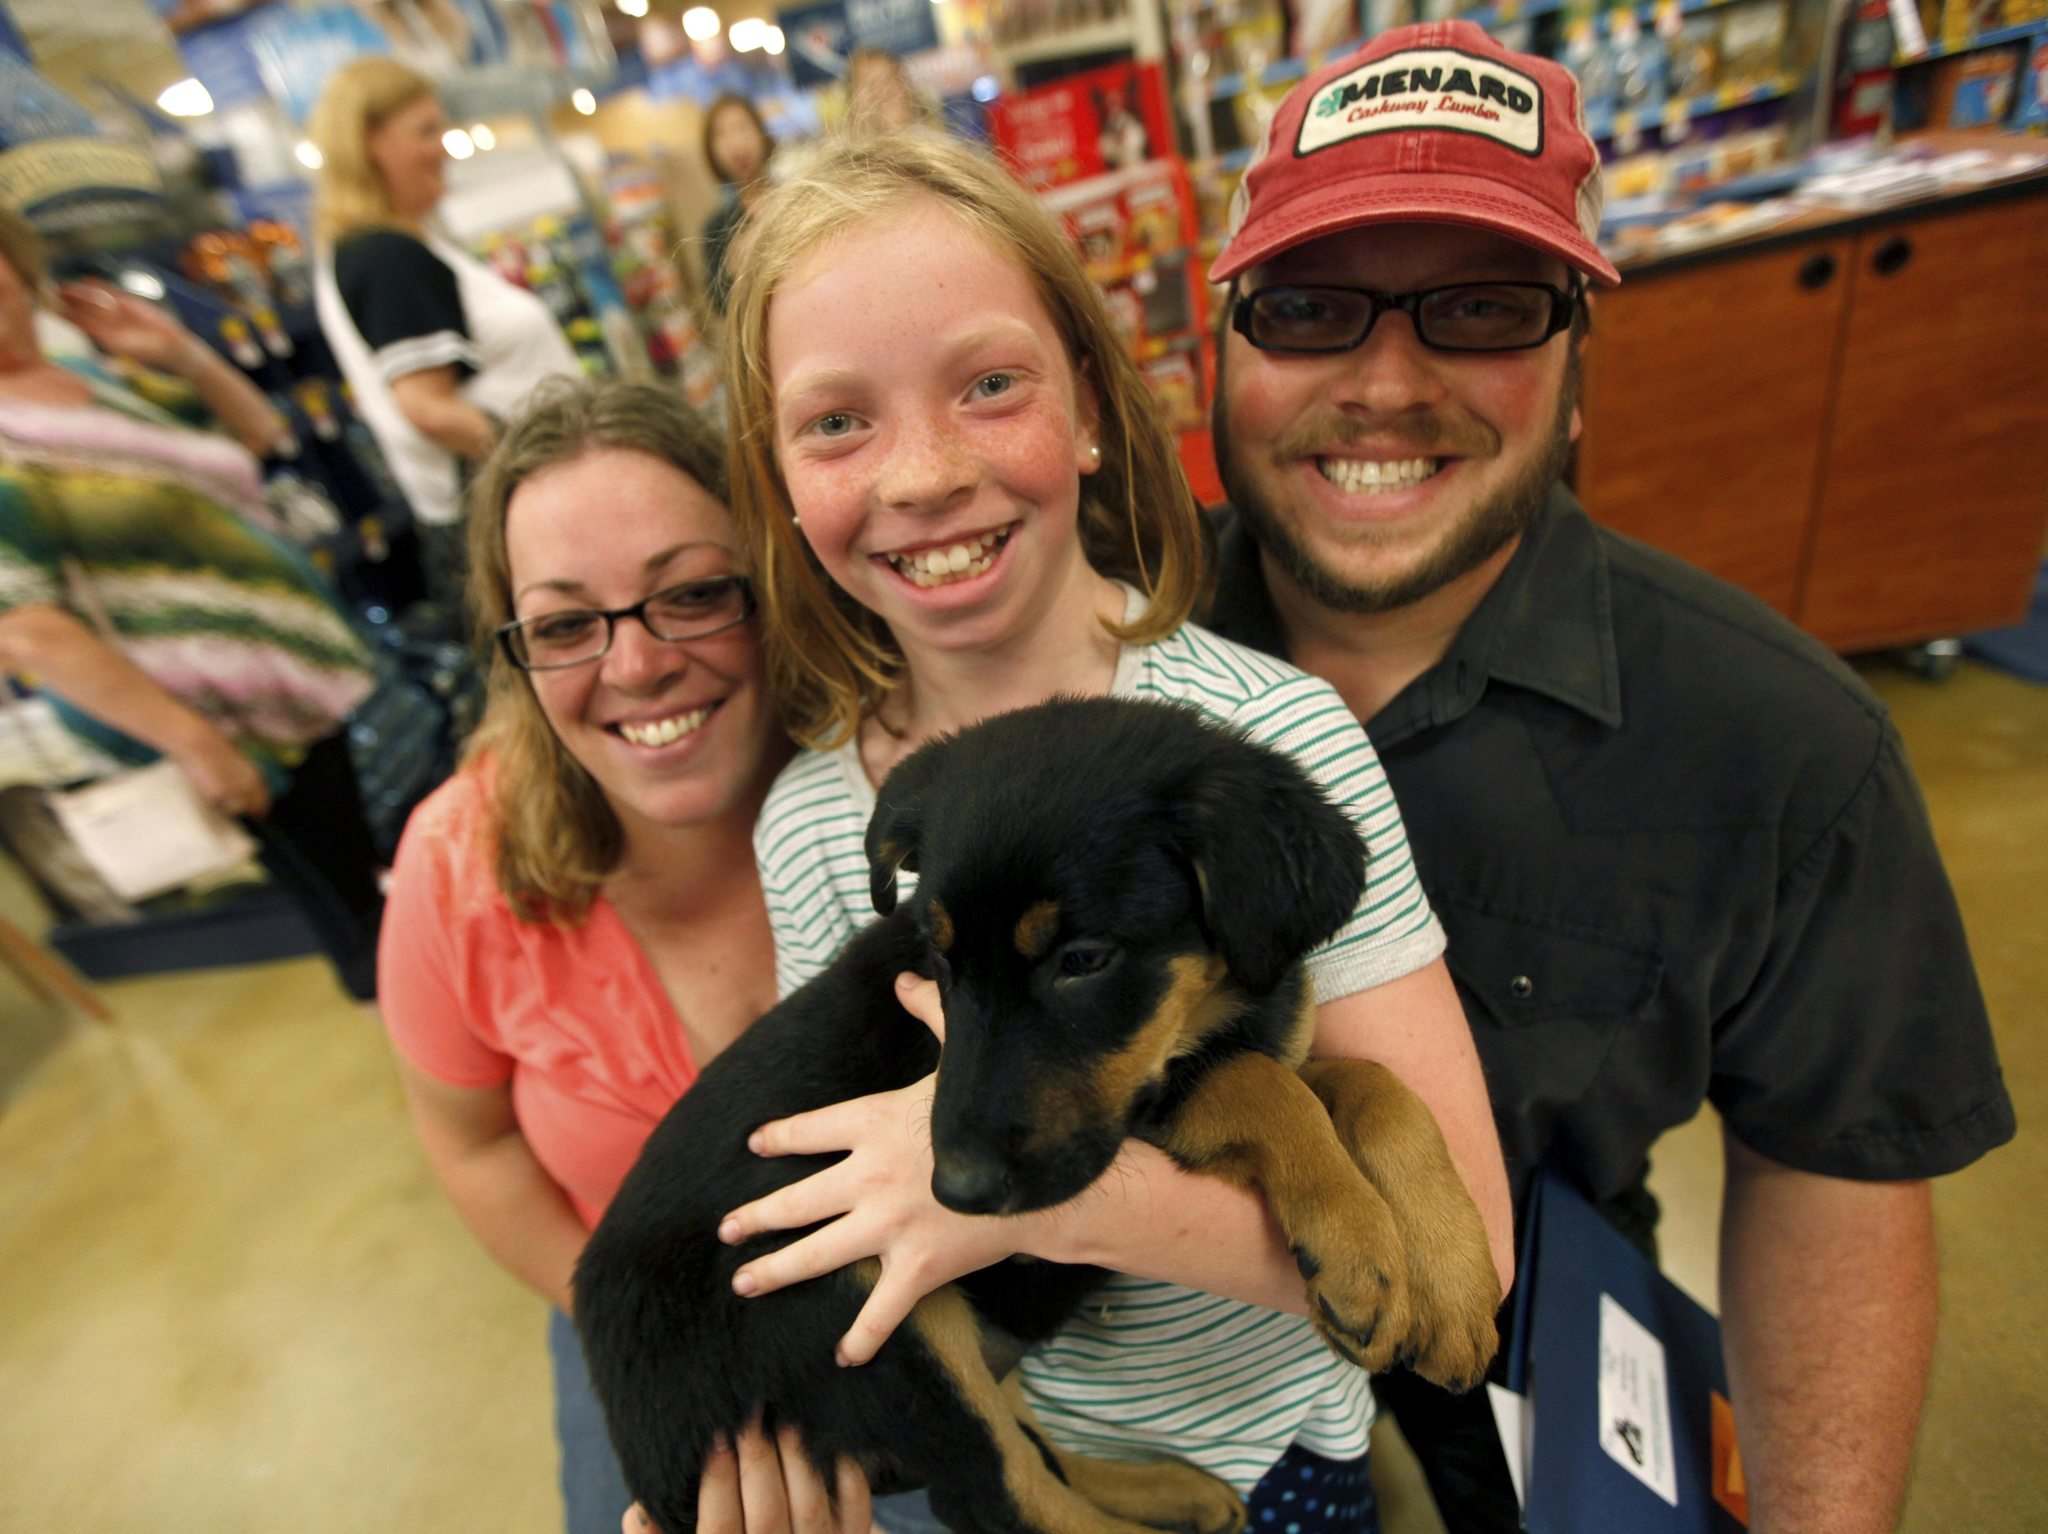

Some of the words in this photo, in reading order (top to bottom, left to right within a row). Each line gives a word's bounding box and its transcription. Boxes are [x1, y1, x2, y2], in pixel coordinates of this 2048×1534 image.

[1340, 68, 1532, 113] MENARD
[1348, 98, 1428, 123] Cashway
[1434, 96, 1500, 121] Lumber
